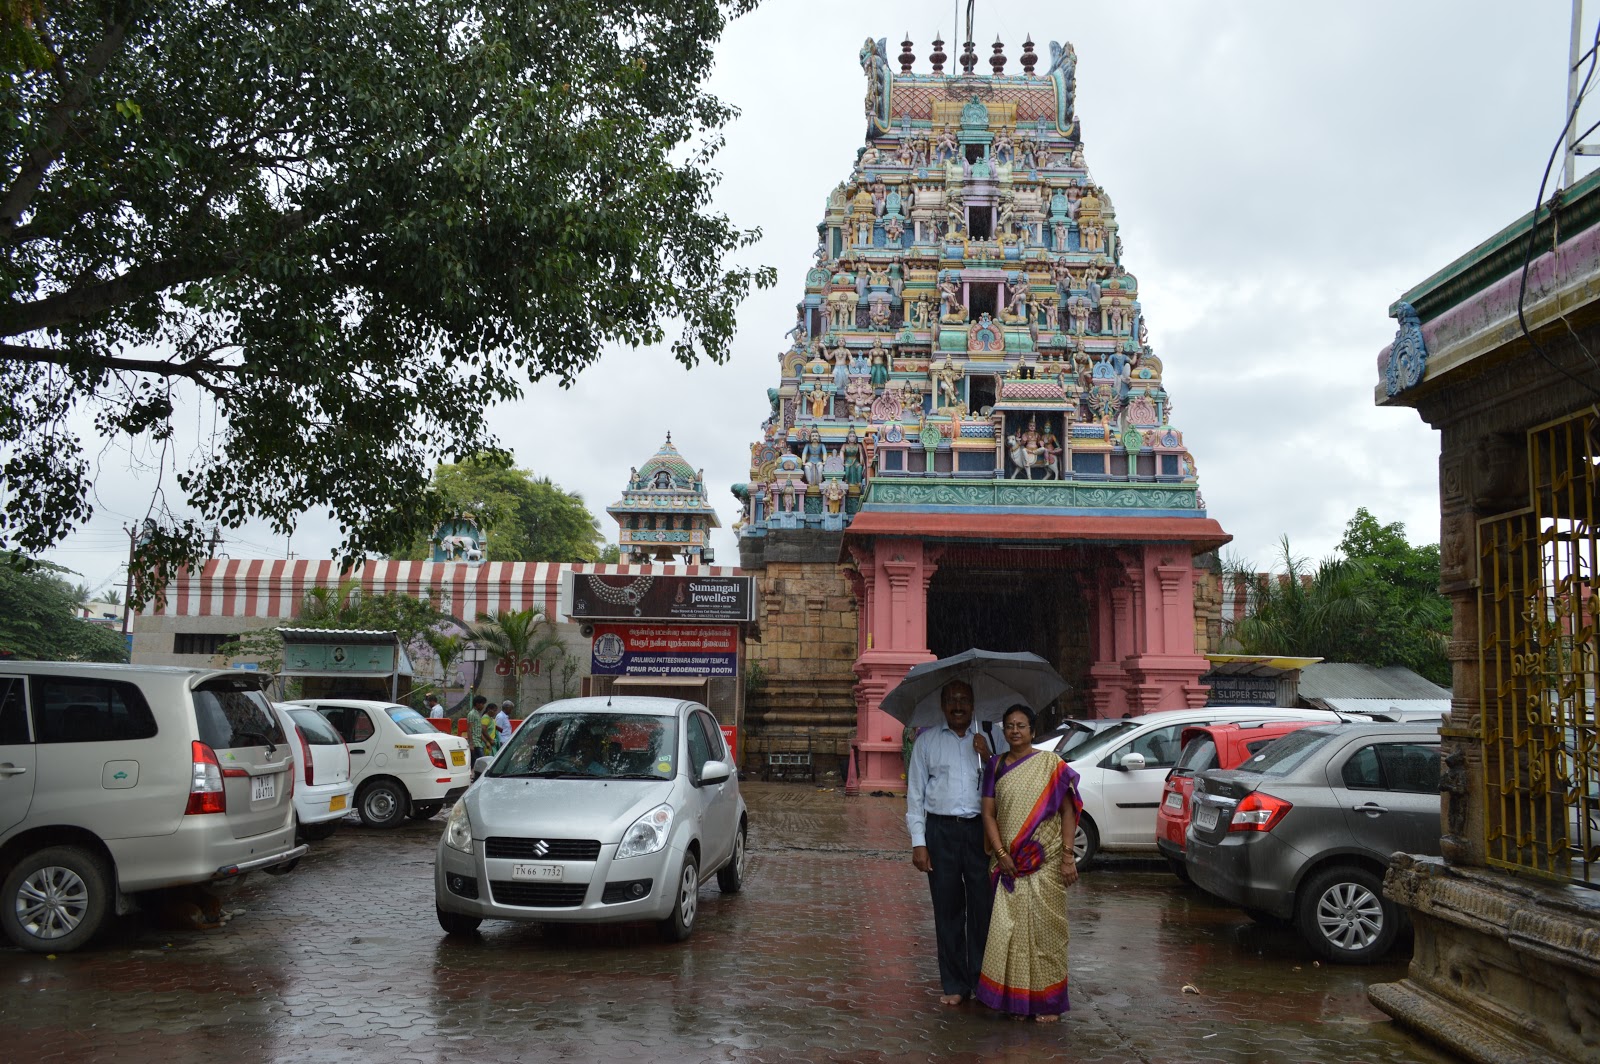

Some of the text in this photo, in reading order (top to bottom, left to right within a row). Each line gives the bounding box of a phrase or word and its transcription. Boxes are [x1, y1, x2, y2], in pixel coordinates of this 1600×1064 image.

[688, 582, 740, 595] Sumangali
[691, 593, 737, 604] Jewellers
[649, 637, 667, 649] நவீன
[701, 638, 730, 649] நிலையம்
[630, 656, 656, 664] ARULMIGU
[656, 656, 691, 664] PATTEESWARA
[709, 657, 729, 665] TEMPLE
[626, 665, 647, 673] PERUR
[670, 666, 711, 674] MODERNIZED
[1217, 690, 1251, 699] SLIPPER
[1252, 691, 1276, 700] STAND
[542, 868, 561, 877] 7732
